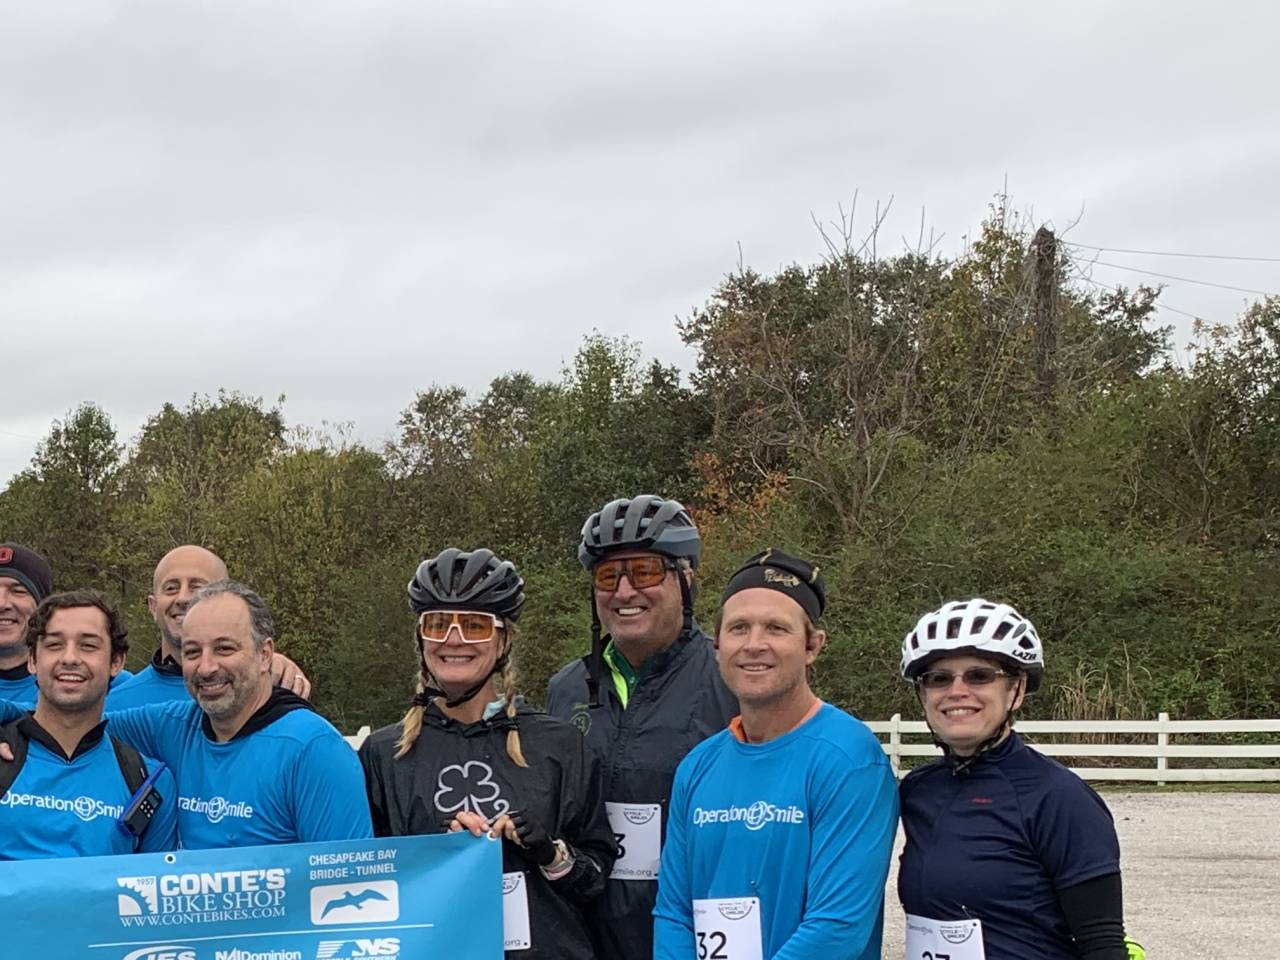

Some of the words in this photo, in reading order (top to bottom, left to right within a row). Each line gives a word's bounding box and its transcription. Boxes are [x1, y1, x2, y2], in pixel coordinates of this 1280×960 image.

[0, 790, 73, 811] Operation
[96, 801, 124, 819] Smi
[223, 801, 253, 818] Smile
[693, 804, 747, 828] Operaon
[764, 805, 804, 824] Smile
[309, 851, 375, 866] CHESAPEAKE
[377, 849, 397, 860] BAY
[614, 833, 626, 859] 3
[160, 868, 287, 897] CONTE'S
[162, 892, 217, 914] BIKE
[222, 890, 286, 909] SHOP
[120, 906, 286, 927] WWW.CONTEBIKES.COM
[697, 931, 728, 960] 32
